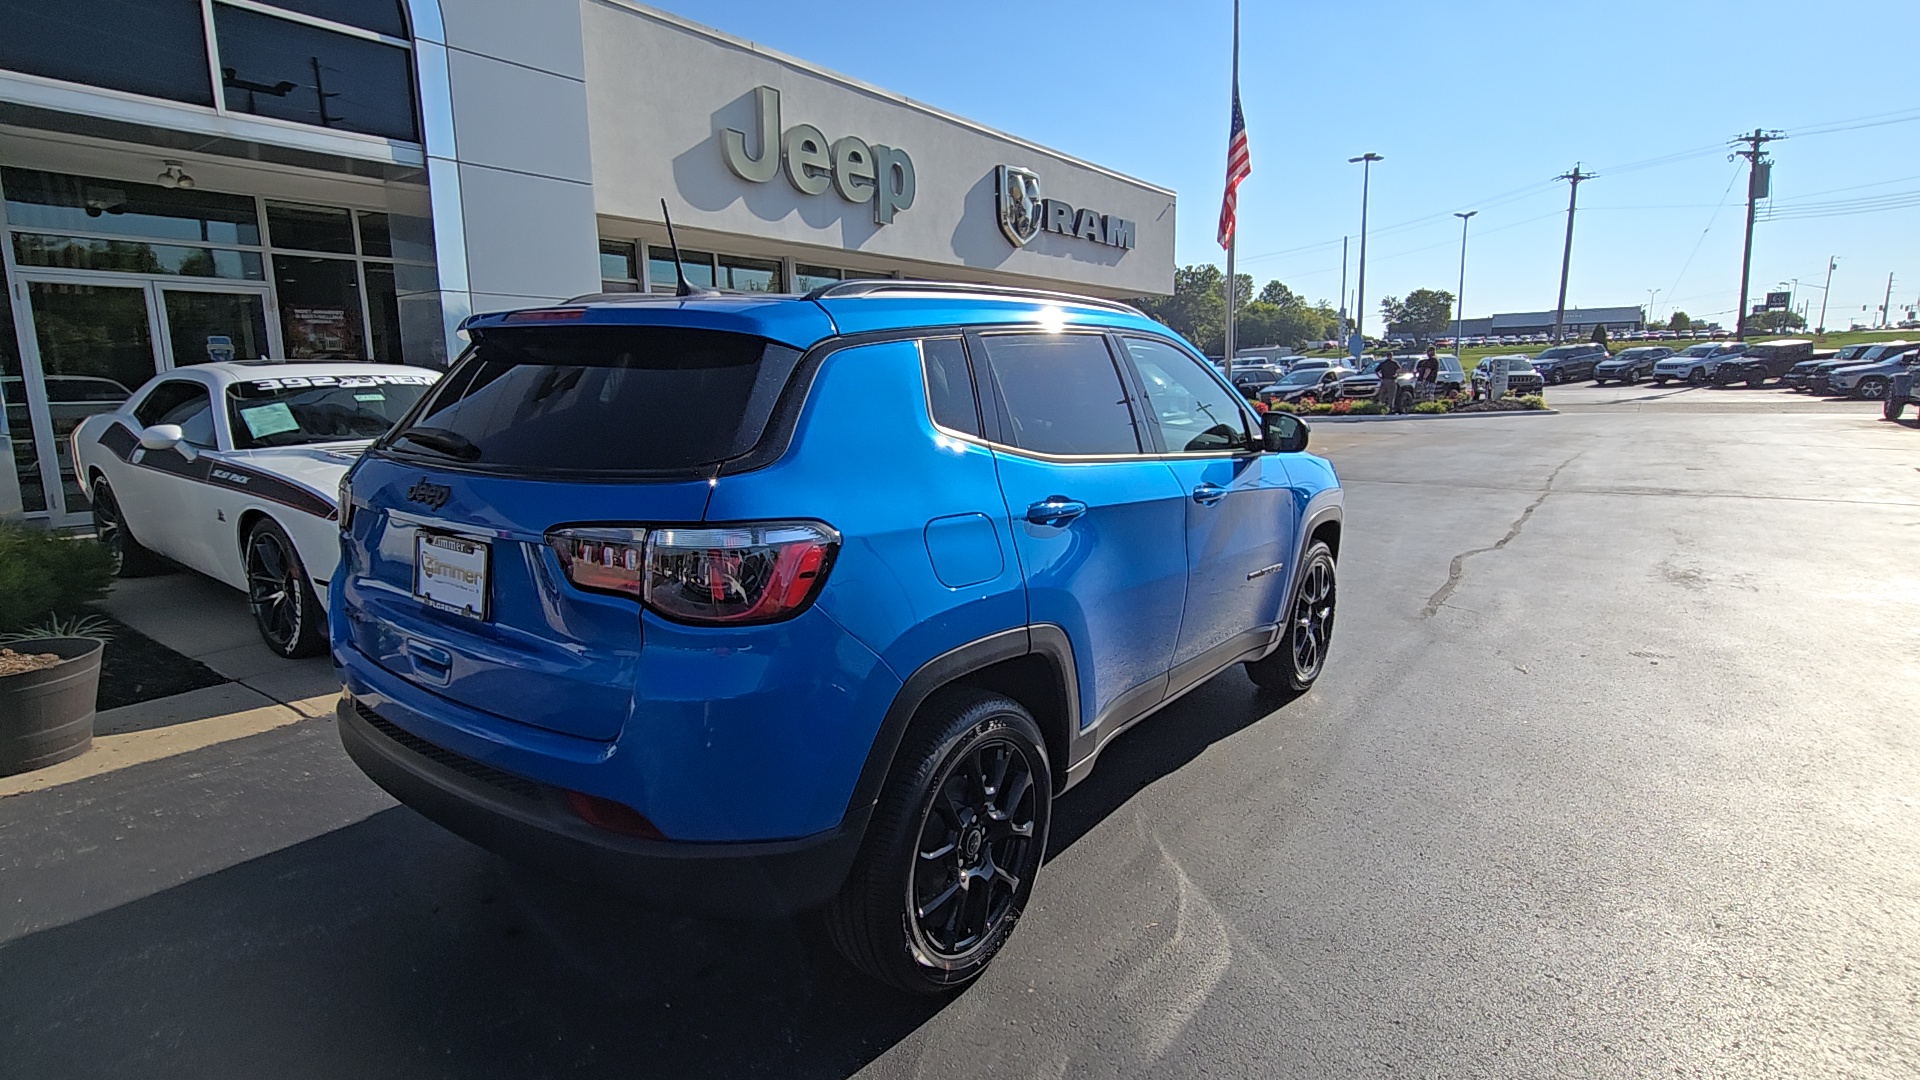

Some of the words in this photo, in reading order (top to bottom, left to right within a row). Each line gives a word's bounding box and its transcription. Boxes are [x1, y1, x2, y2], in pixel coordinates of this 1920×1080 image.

[720, 85, 916, 226] Jeep
[1041, 198, 1136, 250] RAM
[251, 376, 339, 391] 392
[372, 375, 438, 387] HEM
[406, 475, 451, 512] Jeep
[431, 536, 466, 552] Zimmer
[424, 554, 482, 586] Zimmer
